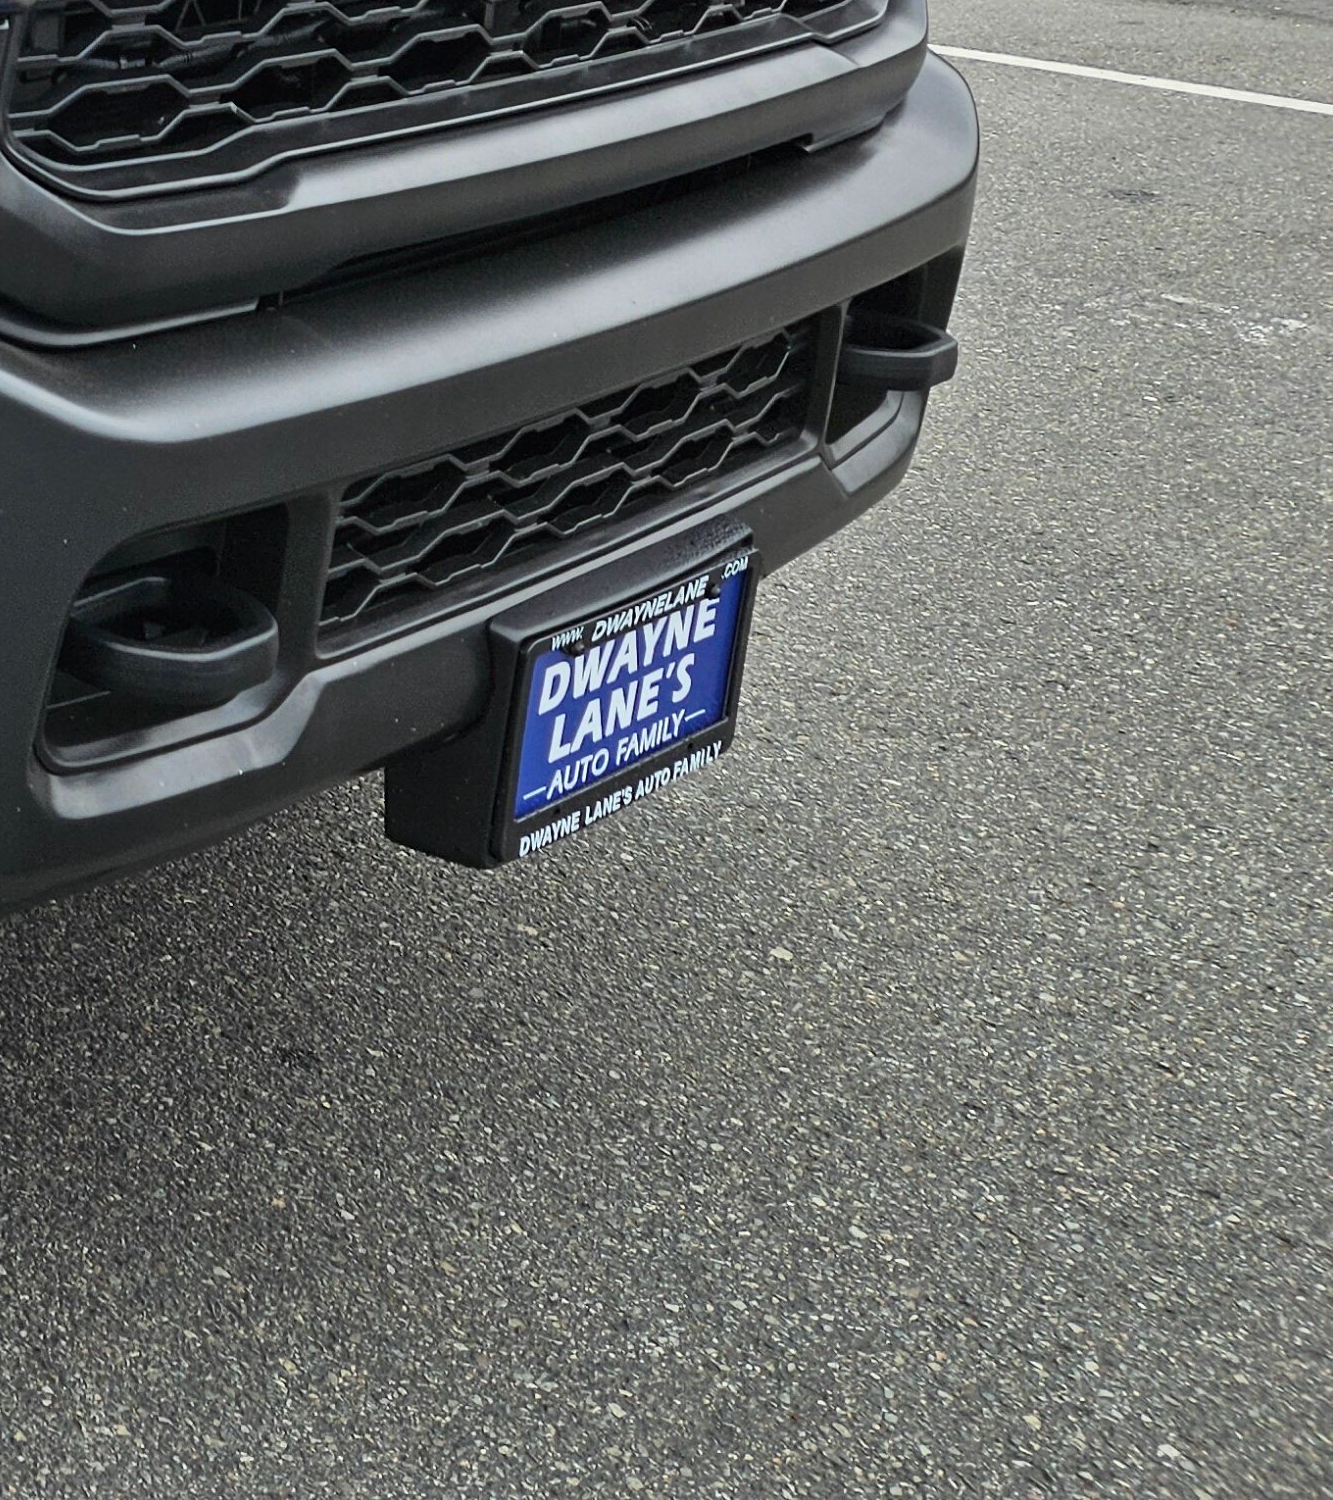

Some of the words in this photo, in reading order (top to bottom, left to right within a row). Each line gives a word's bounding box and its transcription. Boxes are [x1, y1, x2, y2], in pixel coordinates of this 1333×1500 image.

[538, 598, 720, 716] DWAYNE
[592, 575, 710, 641] DWAYNELANE
[546, 747, 609, 800] AUTO
[615, 708, 686, 766] FAMILY
[548, 653, 695, 763] LANE'S
[519, 810, 581, 858] DWAYNE
[584, 785, 633, 825] LANE'S
[635, 766, 671, 800] AUTO
[672, 740, 722, 781] FAMILY
